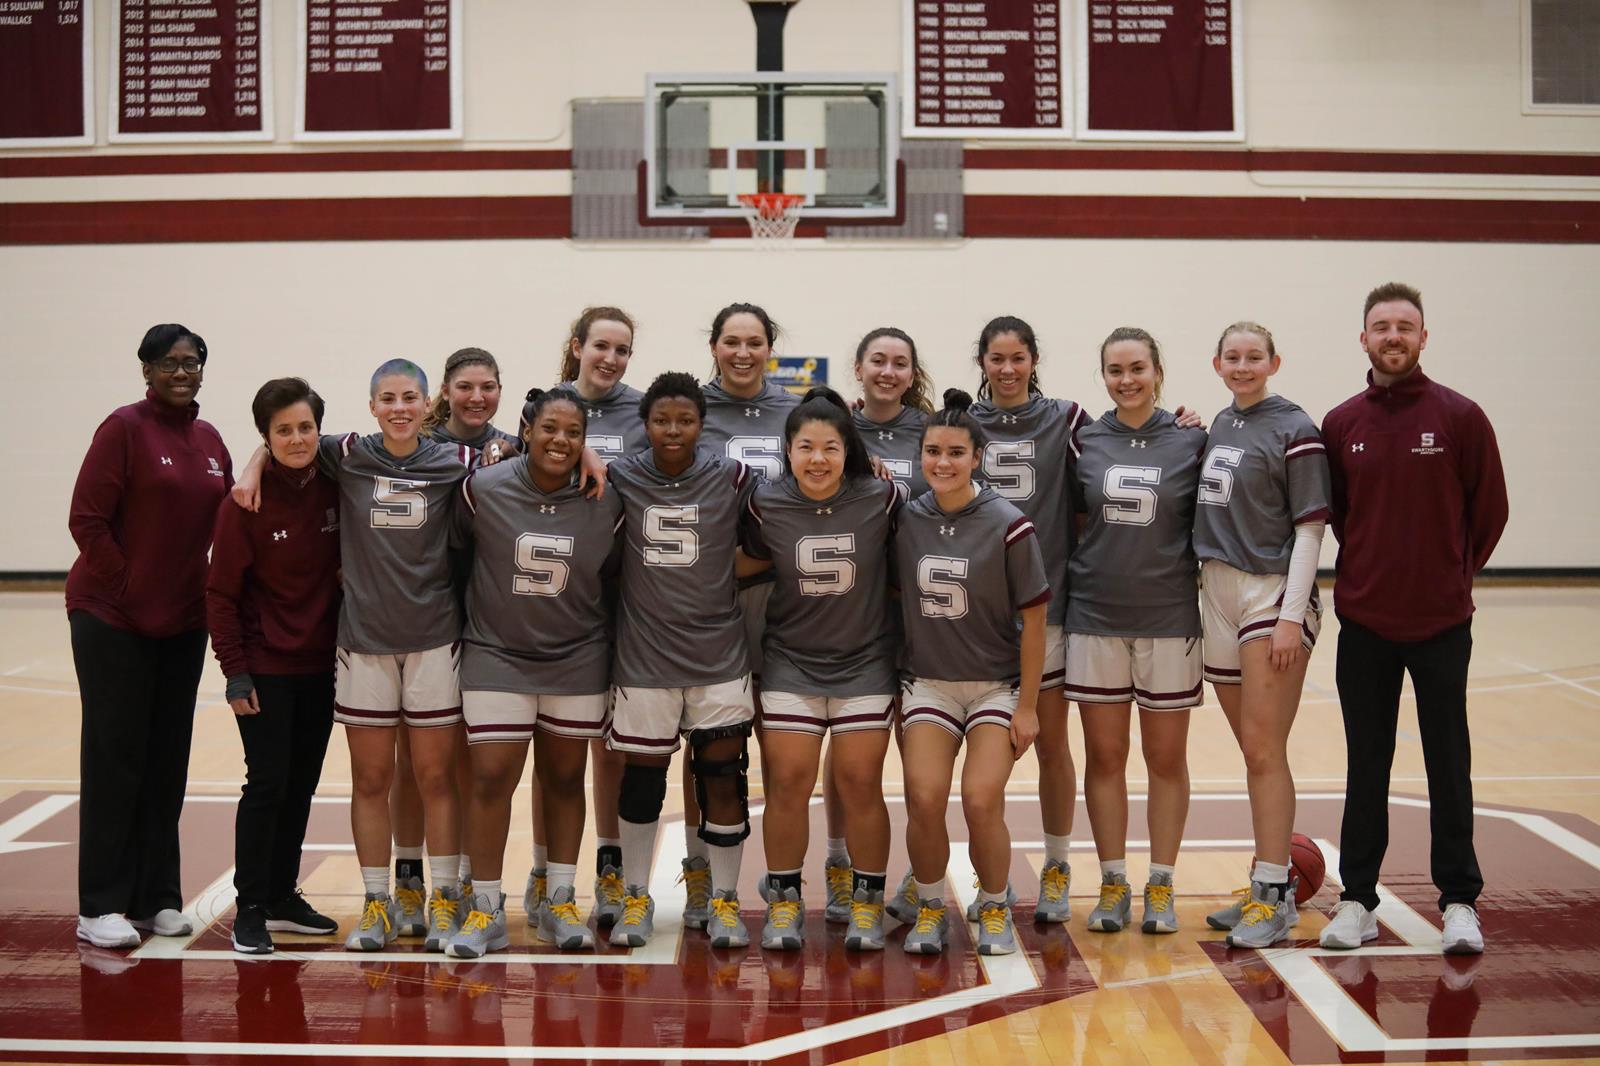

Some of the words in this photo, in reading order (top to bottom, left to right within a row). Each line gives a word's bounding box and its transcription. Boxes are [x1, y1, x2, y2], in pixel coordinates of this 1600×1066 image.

[0, 16, 31, 24] WALLACE
[59, 15, 78, 23] 1,576
[10, 2, 43, 10] SULLIVAN
[60, 1, 78, 9] 1,017
[186, 37, 220, 46] SULLIVAN
[177, 79, 209, 88] WALLACE
[982, 440, 1036, 500] S
[1421, 433, 1434, 447] S
[1103, 464, 1162, 526] S
[1197, 445, 1244, 507] S
[512, 532, 574, 597] S
[643, 504, 698, 567] S
[796, 533, 856, 596] S
[917, 554, 968, 619] S
